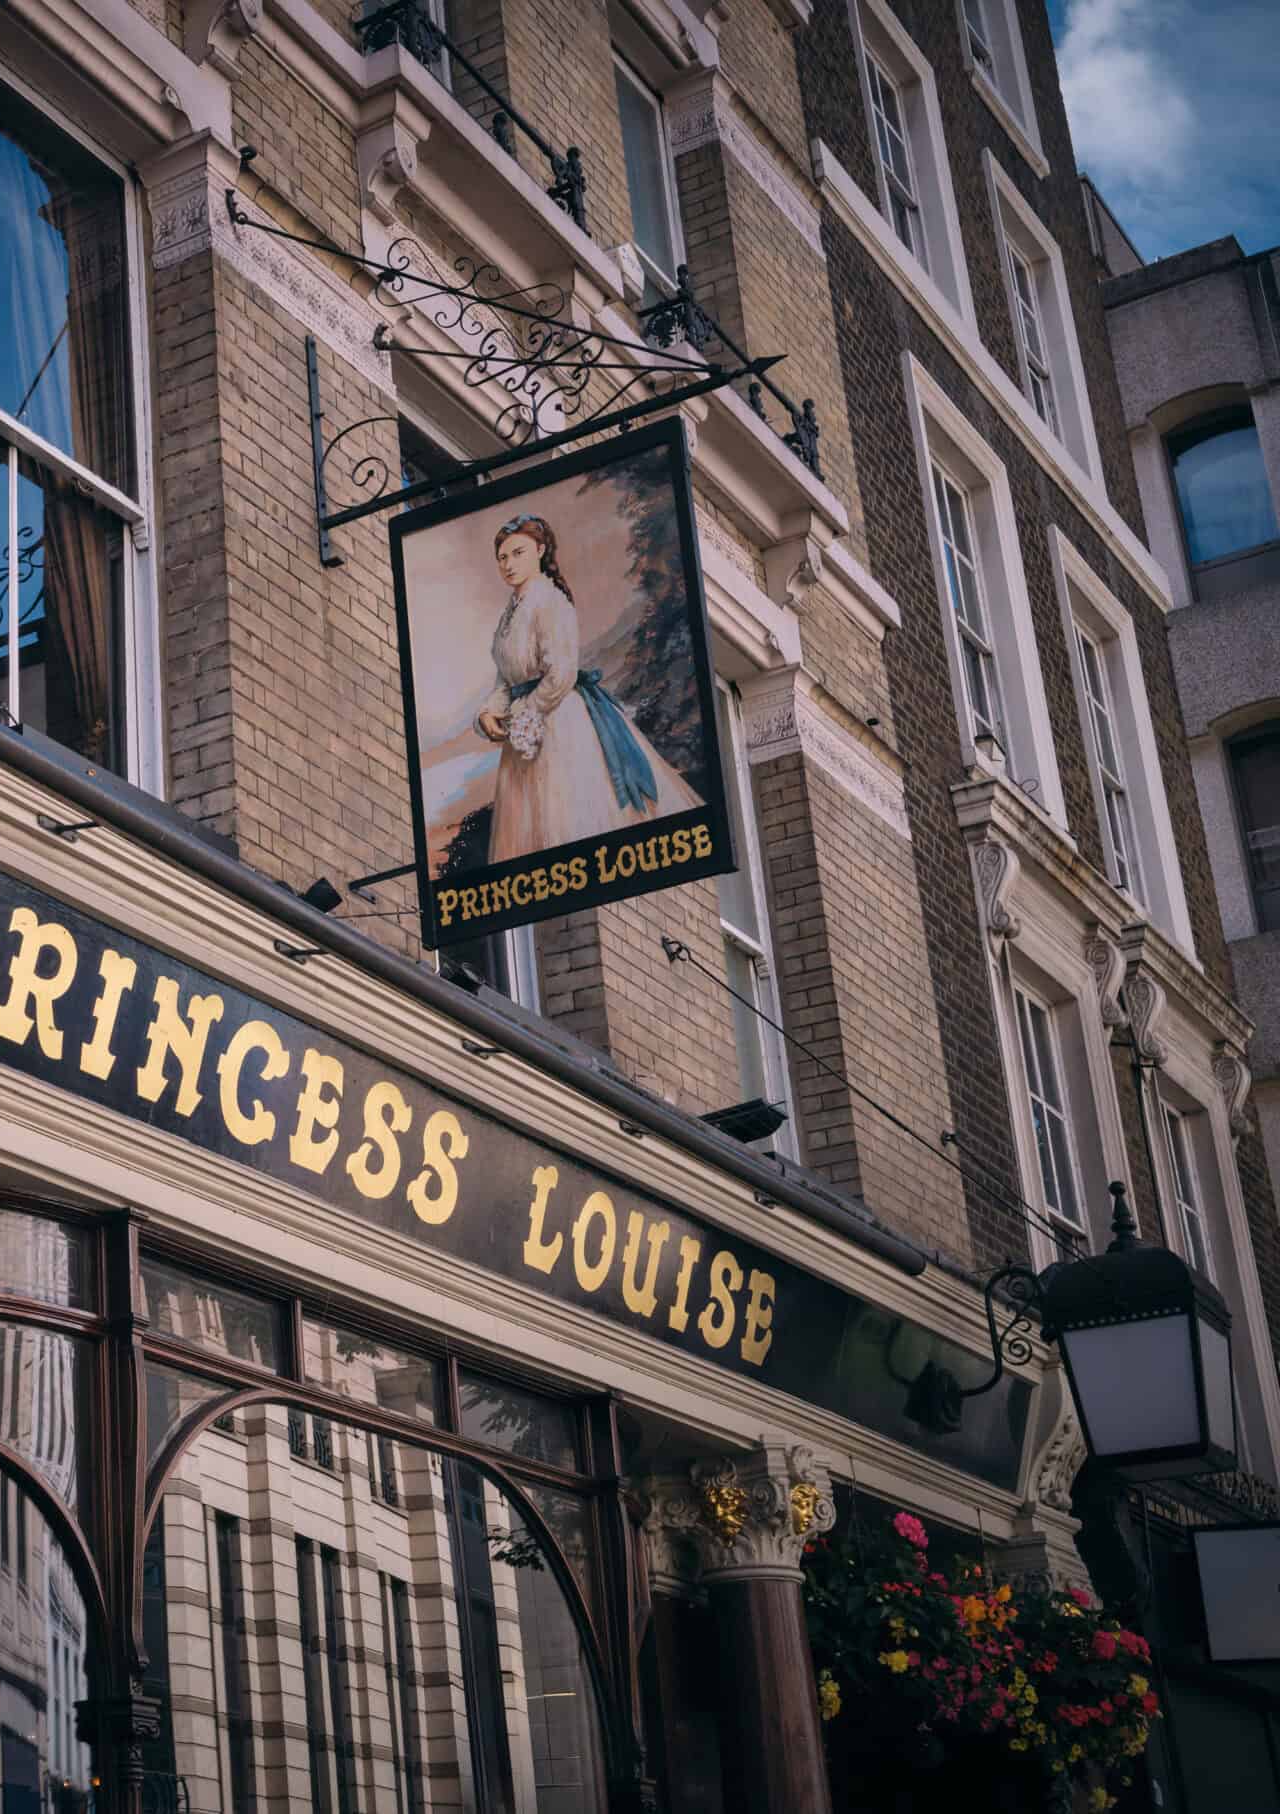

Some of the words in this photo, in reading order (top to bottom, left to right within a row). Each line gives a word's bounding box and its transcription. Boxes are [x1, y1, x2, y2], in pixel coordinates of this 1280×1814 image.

[437, 858, 588, 926] PRINCESS
[595, 825, 712, 883] LOUISE
[523, 1165, 777, 1366] LOUISE
